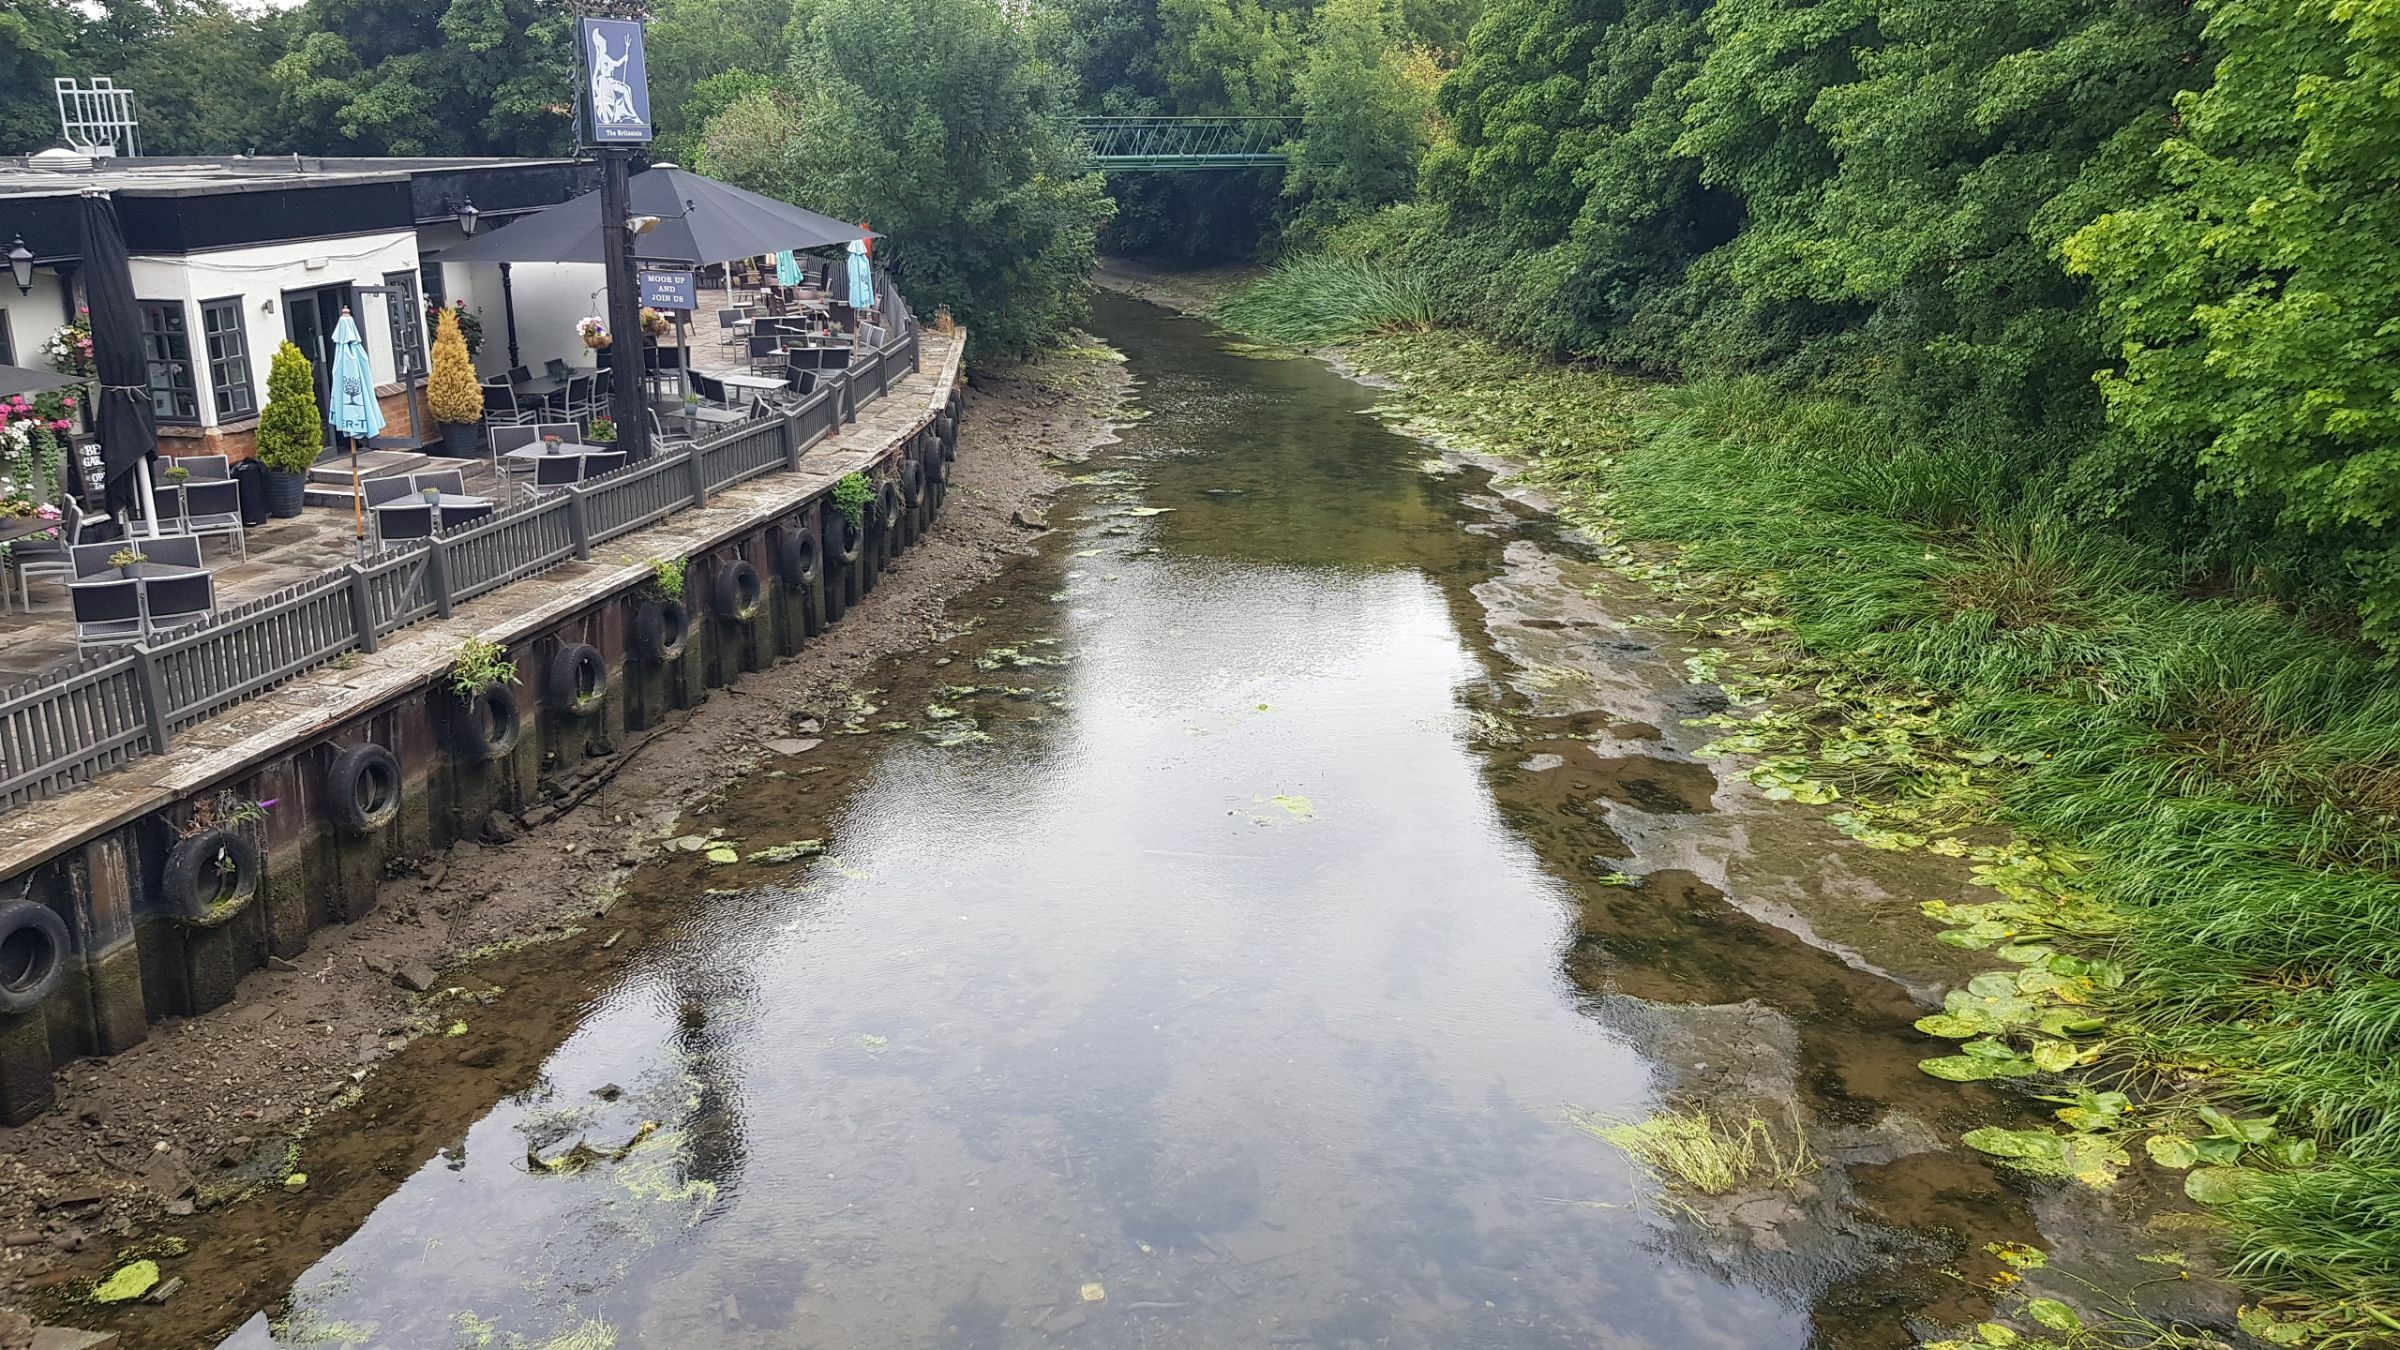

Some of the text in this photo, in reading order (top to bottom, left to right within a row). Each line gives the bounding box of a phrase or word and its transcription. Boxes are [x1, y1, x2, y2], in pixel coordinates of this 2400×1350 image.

[606, 129, 617, 137] The
[648, 275, 686, 284] MOOR UP
[658, 285, 676, 293] AND
[651, 294, 684, 303] JOIN US
[84, 443, 102, 456] BE
[83, 455, 105, 467] GAR
[91, 472, 106, 482] OP
